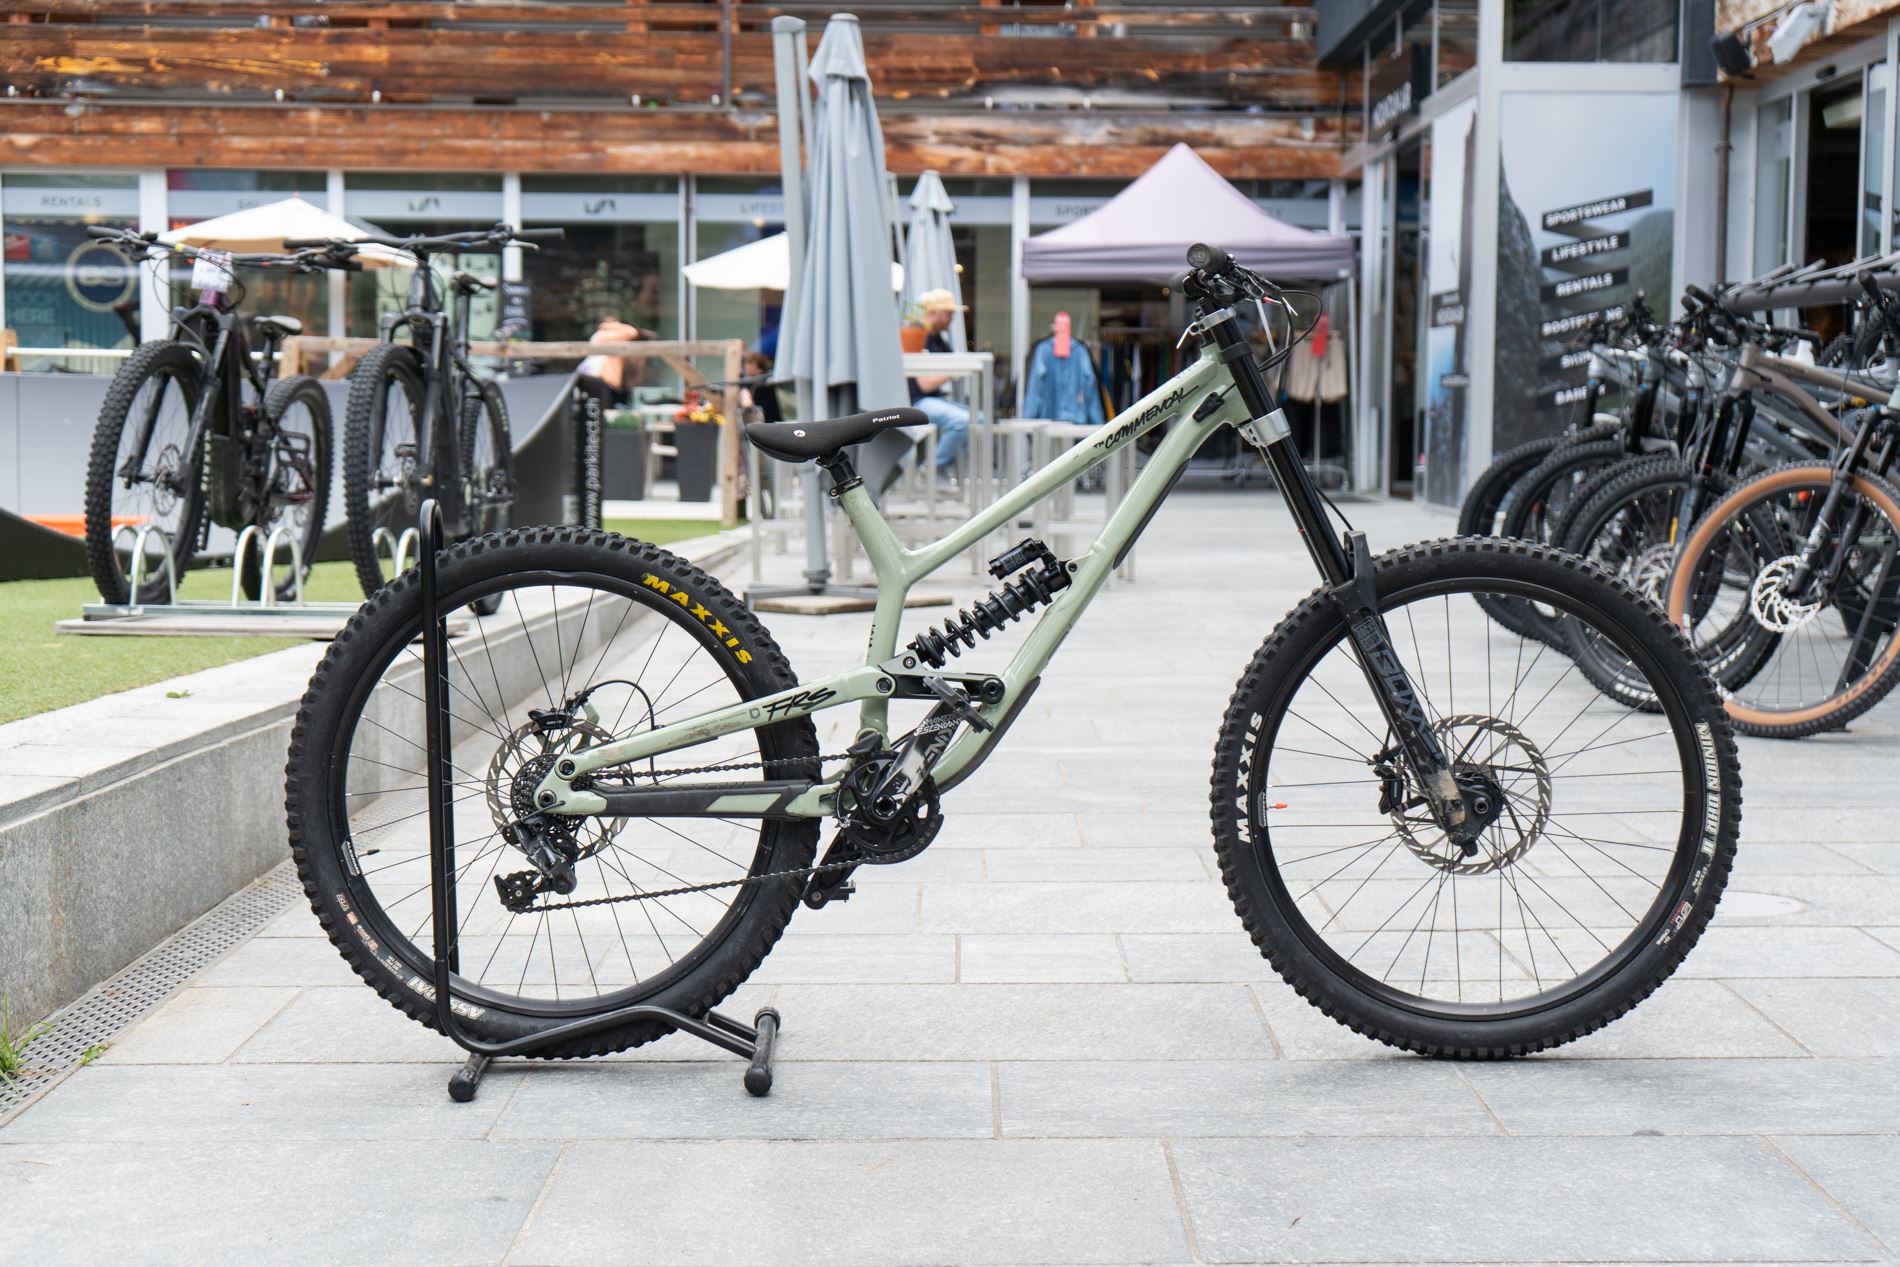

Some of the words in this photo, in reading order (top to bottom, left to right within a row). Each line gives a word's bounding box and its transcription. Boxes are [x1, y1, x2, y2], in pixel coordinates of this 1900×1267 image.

[41, 195, 102, 208] RENTALS
[1545, 197, 1627, 228] SPORTSWEAR
[1551, 234, 1619, 262] LIFESTYLE
[1555, 272, 1614, 298] RENTALS
[1542, 306, 1623, 336] BOOTFITTNG
[872, 414, 901, 423] Patriot
[643, 575, 752, 664] MAXXIS
[762, 687, 837, 721] FRS
[1695, 722, 1720, 792] MINION
[1235, 711, 1263, 844] MAXXIS
[1705, 792, 1721, 836] DHR
[1700, 837, 1717, 857] II
[406, 976, 486, 1020] ASSGAI
